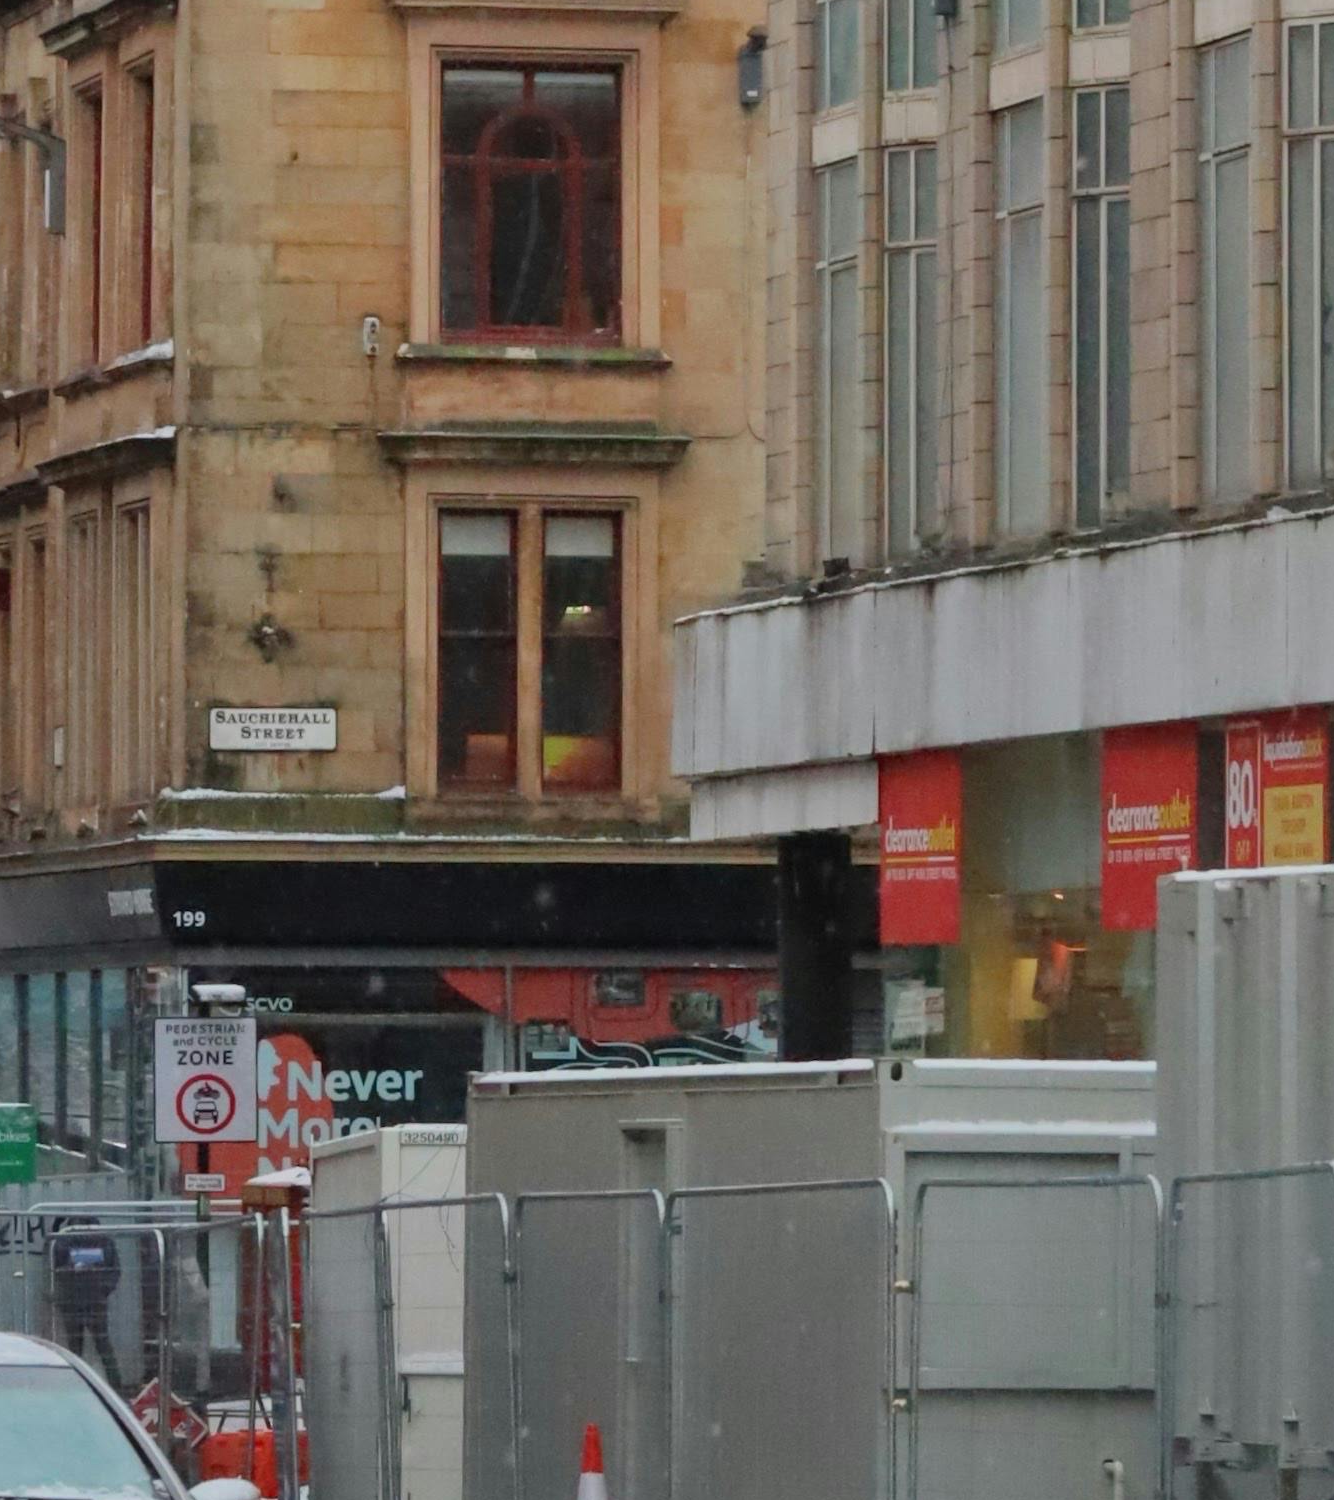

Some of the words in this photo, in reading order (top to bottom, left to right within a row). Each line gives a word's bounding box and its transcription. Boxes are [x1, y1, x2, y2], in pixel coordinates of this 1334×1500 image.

[215, 711, 331, 724] SAUCHIEHALL
[241, 726, 306, 739] STREET
[172, 911, 206, 928] 199
[245, 997, 293, 1012] SCVO
[165, 1023, 245, 1034] PEDESTRIAN
[172, 1036, 194, 1046] and
[197, 1036, 238, 1046] CYCLE
[177, 1051, 234, 1065] ZONE
[287, 1061, 424, 1101] Never
